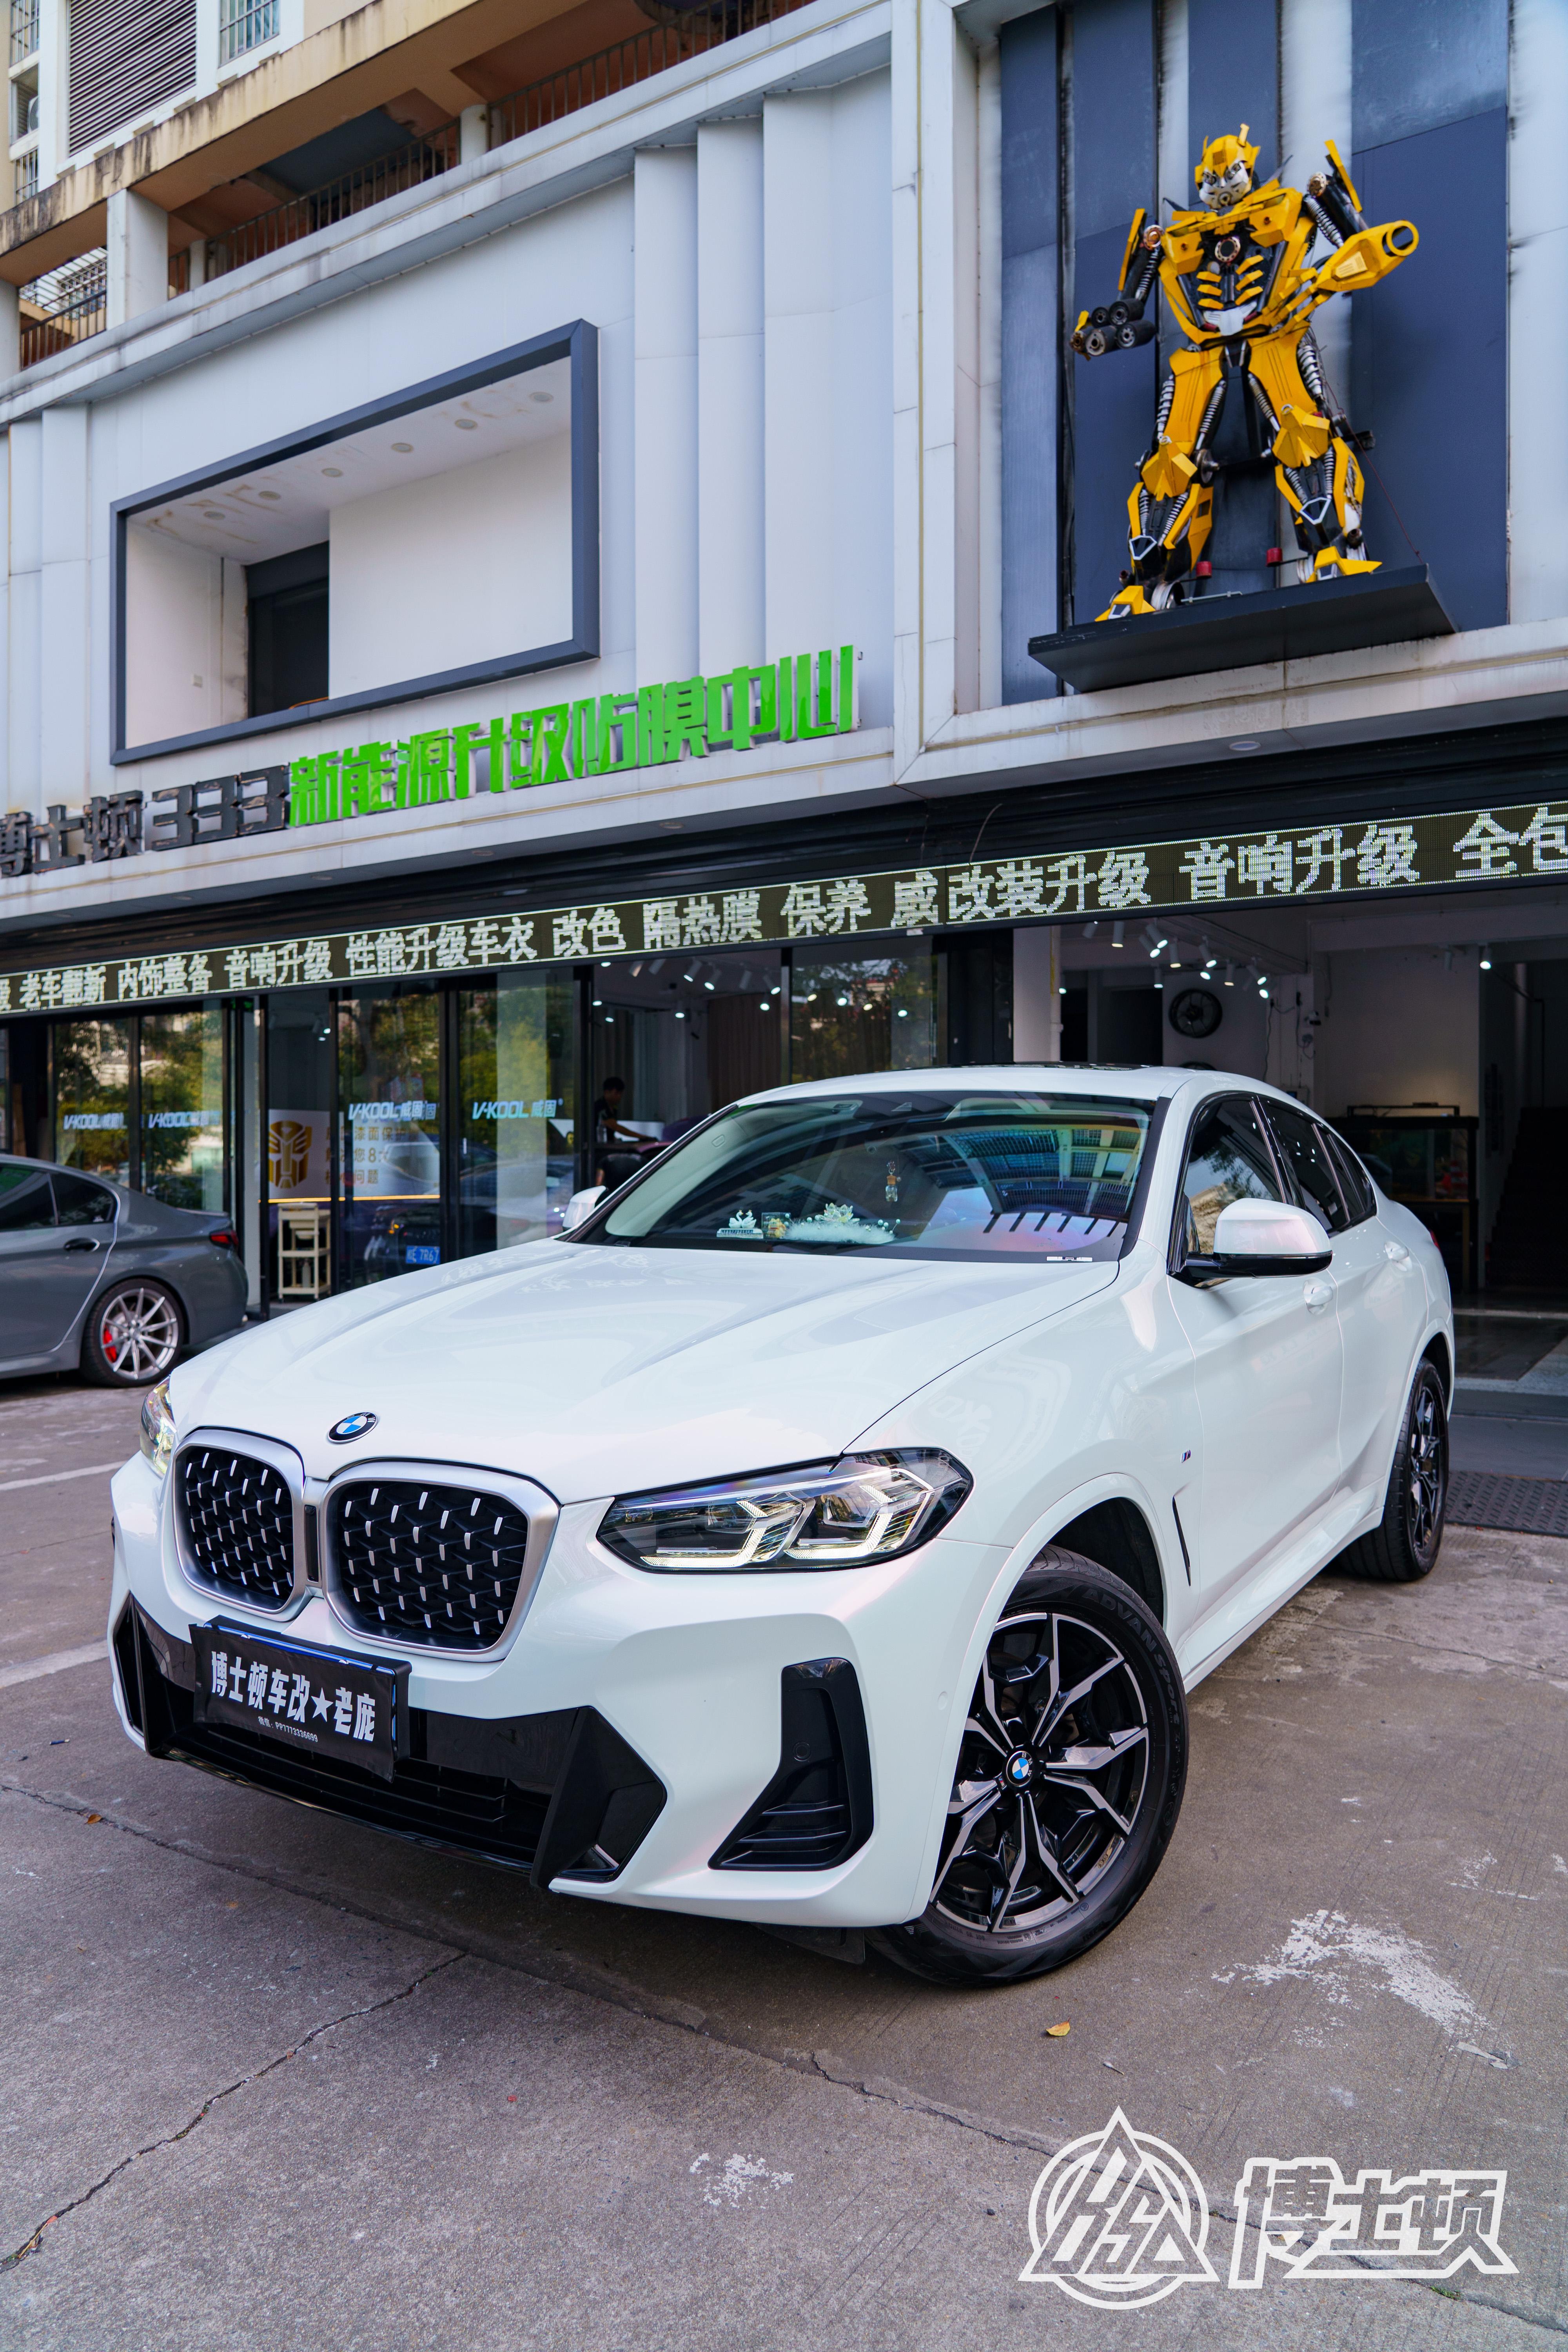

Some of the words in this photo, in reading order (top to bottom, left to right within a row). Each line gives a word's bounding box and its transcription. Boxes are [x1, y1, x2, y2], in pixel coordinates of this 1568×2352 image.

[224, 941, 333, 989] 音响升级
[553, 906, 626, 958] 改色
[643, 890, 762, 949] 隔热膜
[780, 879, 871, 938] 保养
[1179, 824, 1421, 900] 音响升级
[1082, 1587, 1157, 1652] ADVAN
